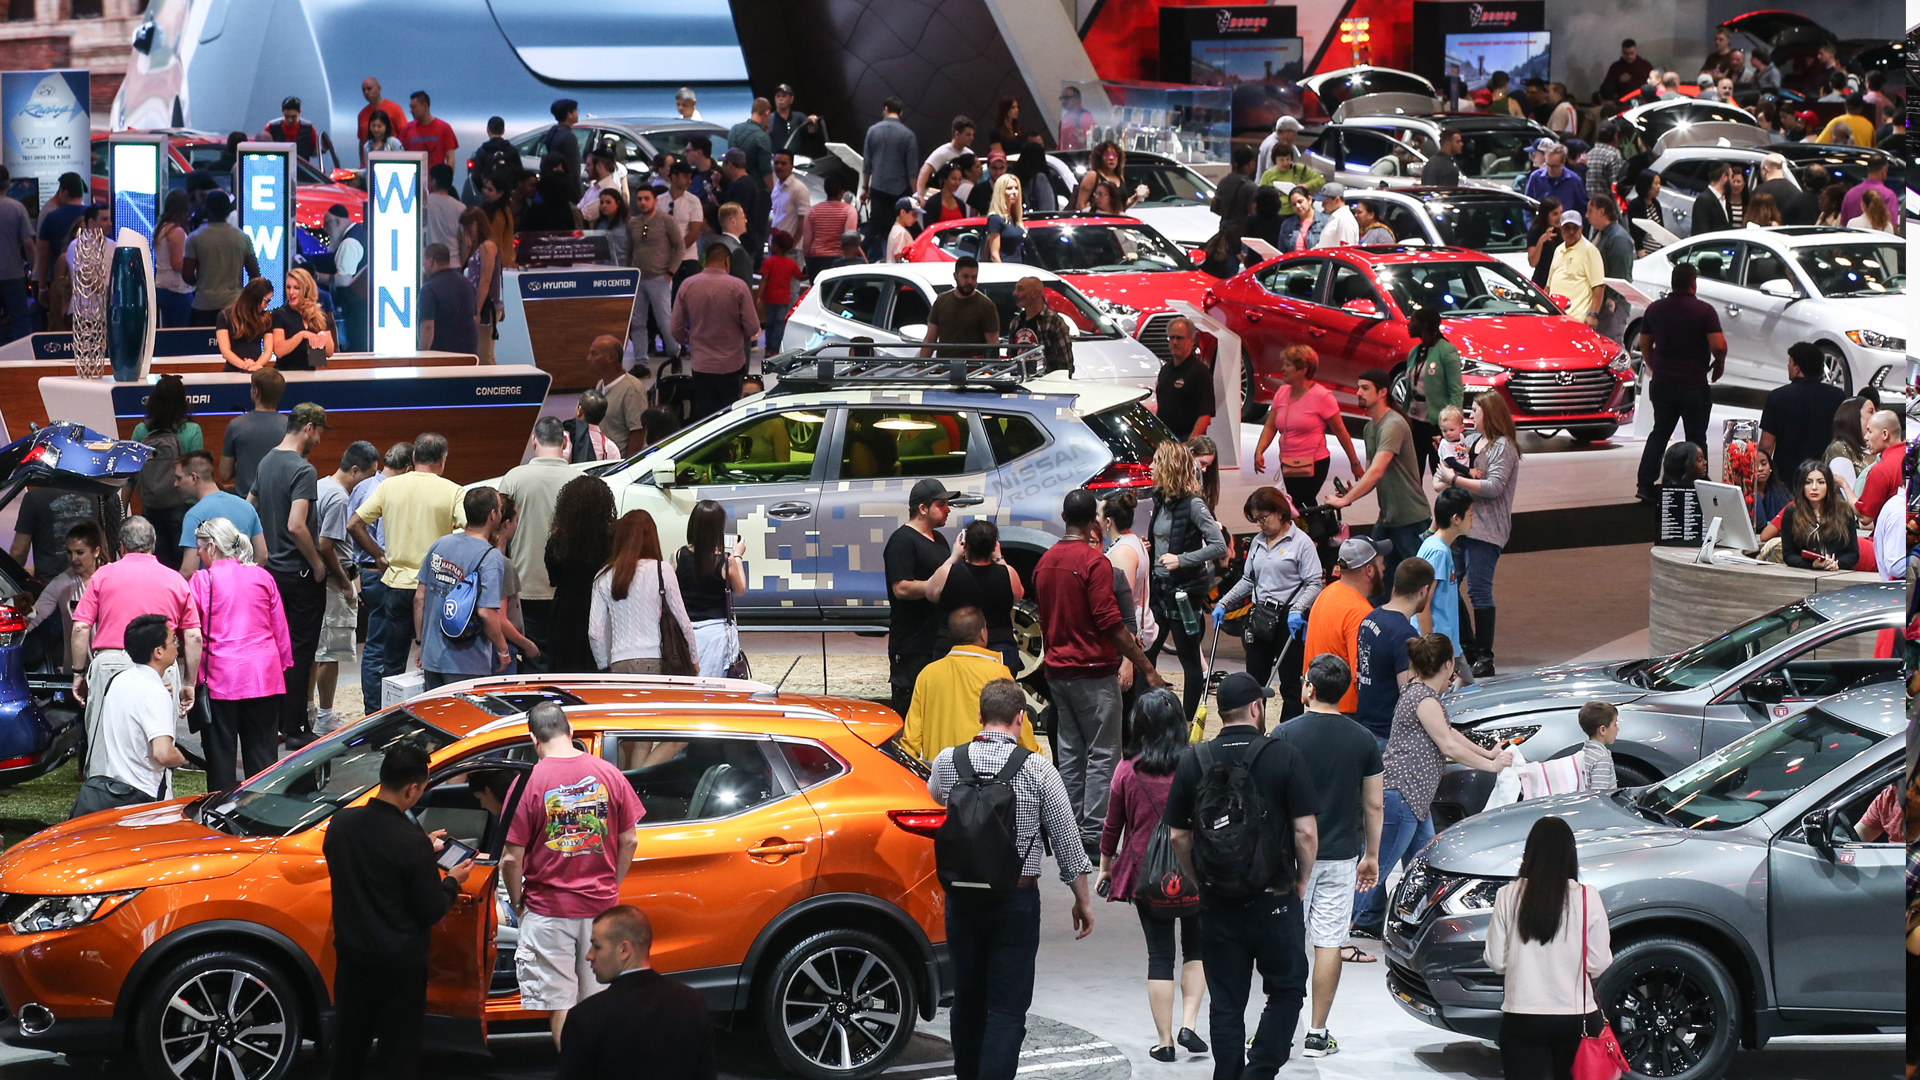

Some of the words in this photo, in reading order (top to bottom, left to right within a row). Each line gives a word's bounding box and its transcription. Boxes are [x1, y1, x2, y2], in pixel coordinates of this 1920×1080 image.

[374, 163, 417, 328] WIN
[543, 281, 577, 289] HYUNDAI
[608, 279, 631, 287] CENTER
[475, 386, 522, 396] CONCIERGE
[992, 443, 1092, 495] NISSAN
[1006, 461, 1091, 505] ROGUE
